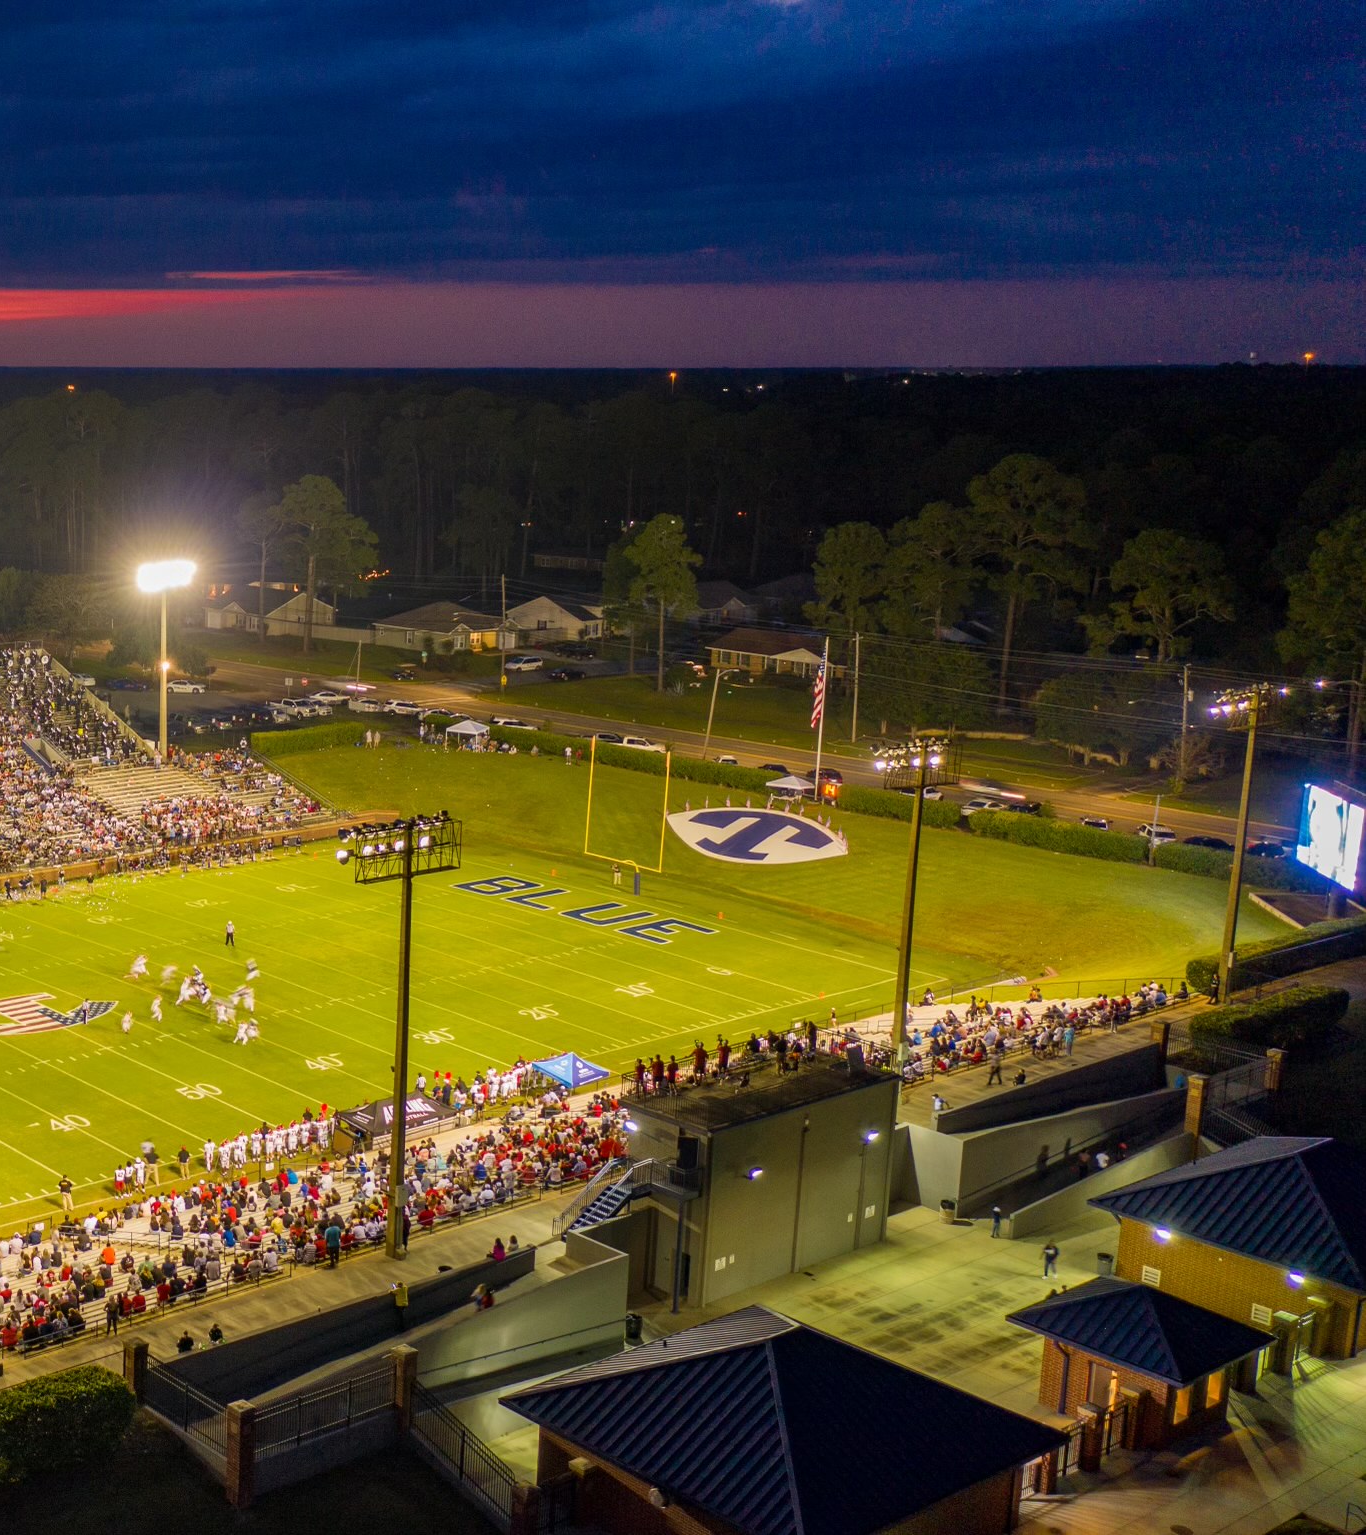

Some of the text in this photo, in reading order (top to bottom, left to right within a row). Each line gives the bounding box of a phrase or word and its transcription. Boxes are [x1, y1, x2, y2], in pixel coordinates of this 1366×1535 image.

[449, 875, 721, 945] BLUE
[614, 983, 655, 998] 10
[518, 1005, 560, 1021] 20
[412, 1029, 456, 1045] 30
[304, 1054, 345, 1072] 40
[175, 1082, 224, 1101] 50
[47, 1113, 92, 1133] 40
